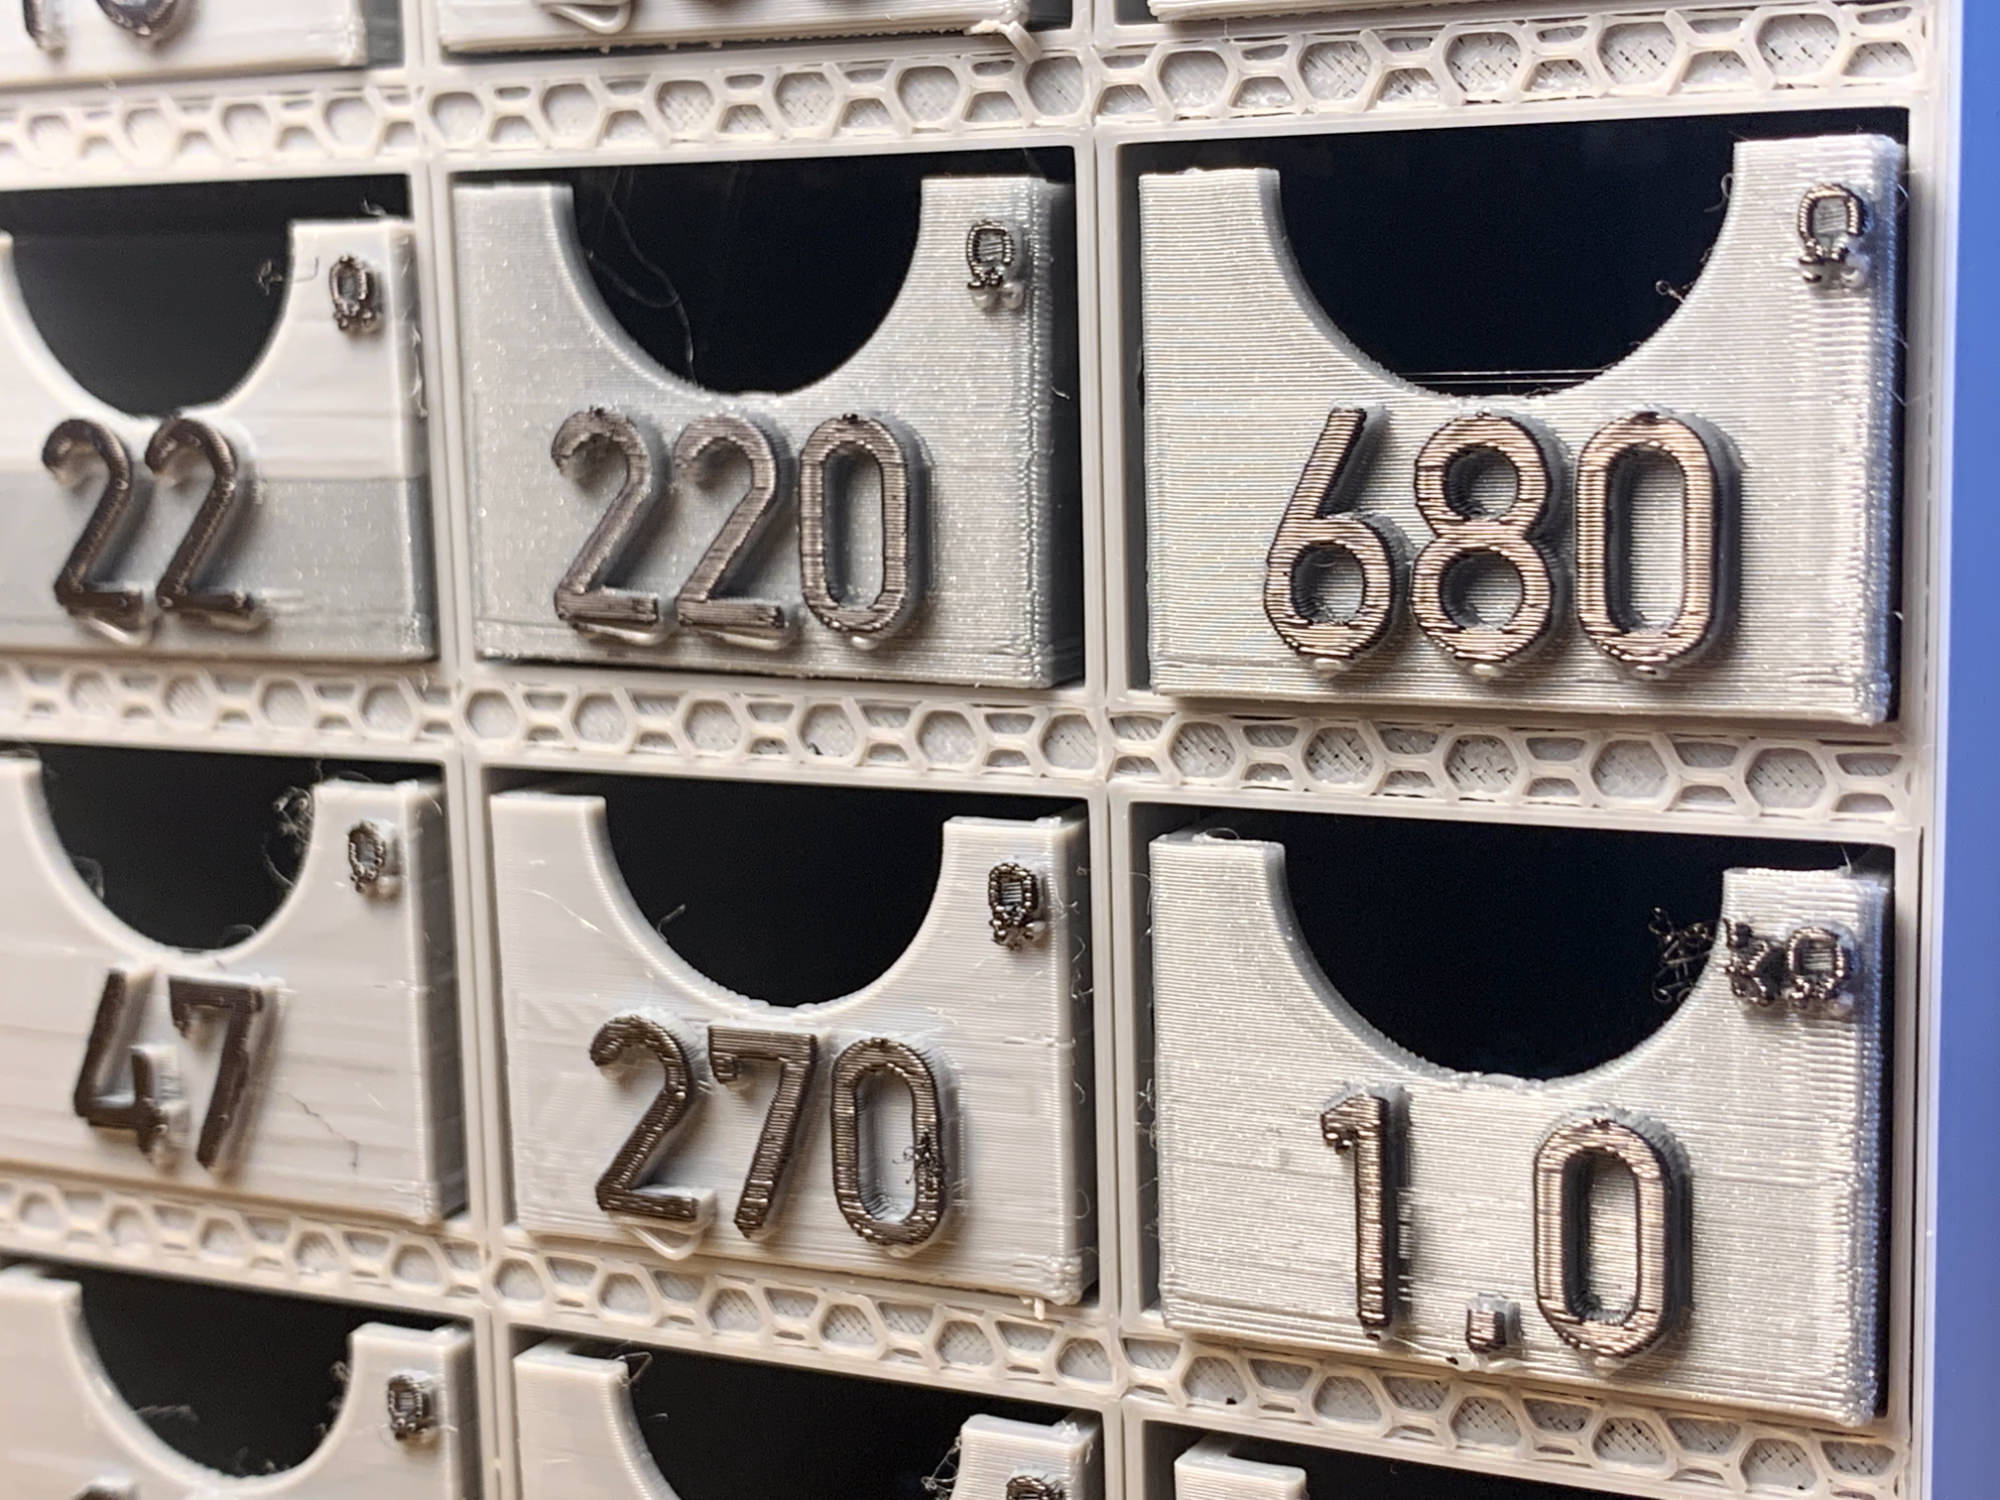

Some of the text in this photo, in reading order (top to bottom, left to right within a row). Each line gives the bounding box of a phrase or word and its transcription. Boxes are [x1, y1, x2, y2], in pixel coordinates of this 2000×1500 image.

[41, 415, 260, 622] 22
[551, 408, 912, 634] 220
[1263, 404, 1722, 674] 680
[73, 966, 268, 1170] 47
[589, 1013, 946, 1248] 270
[1320, 1093, 1672, 1362] 1.0
